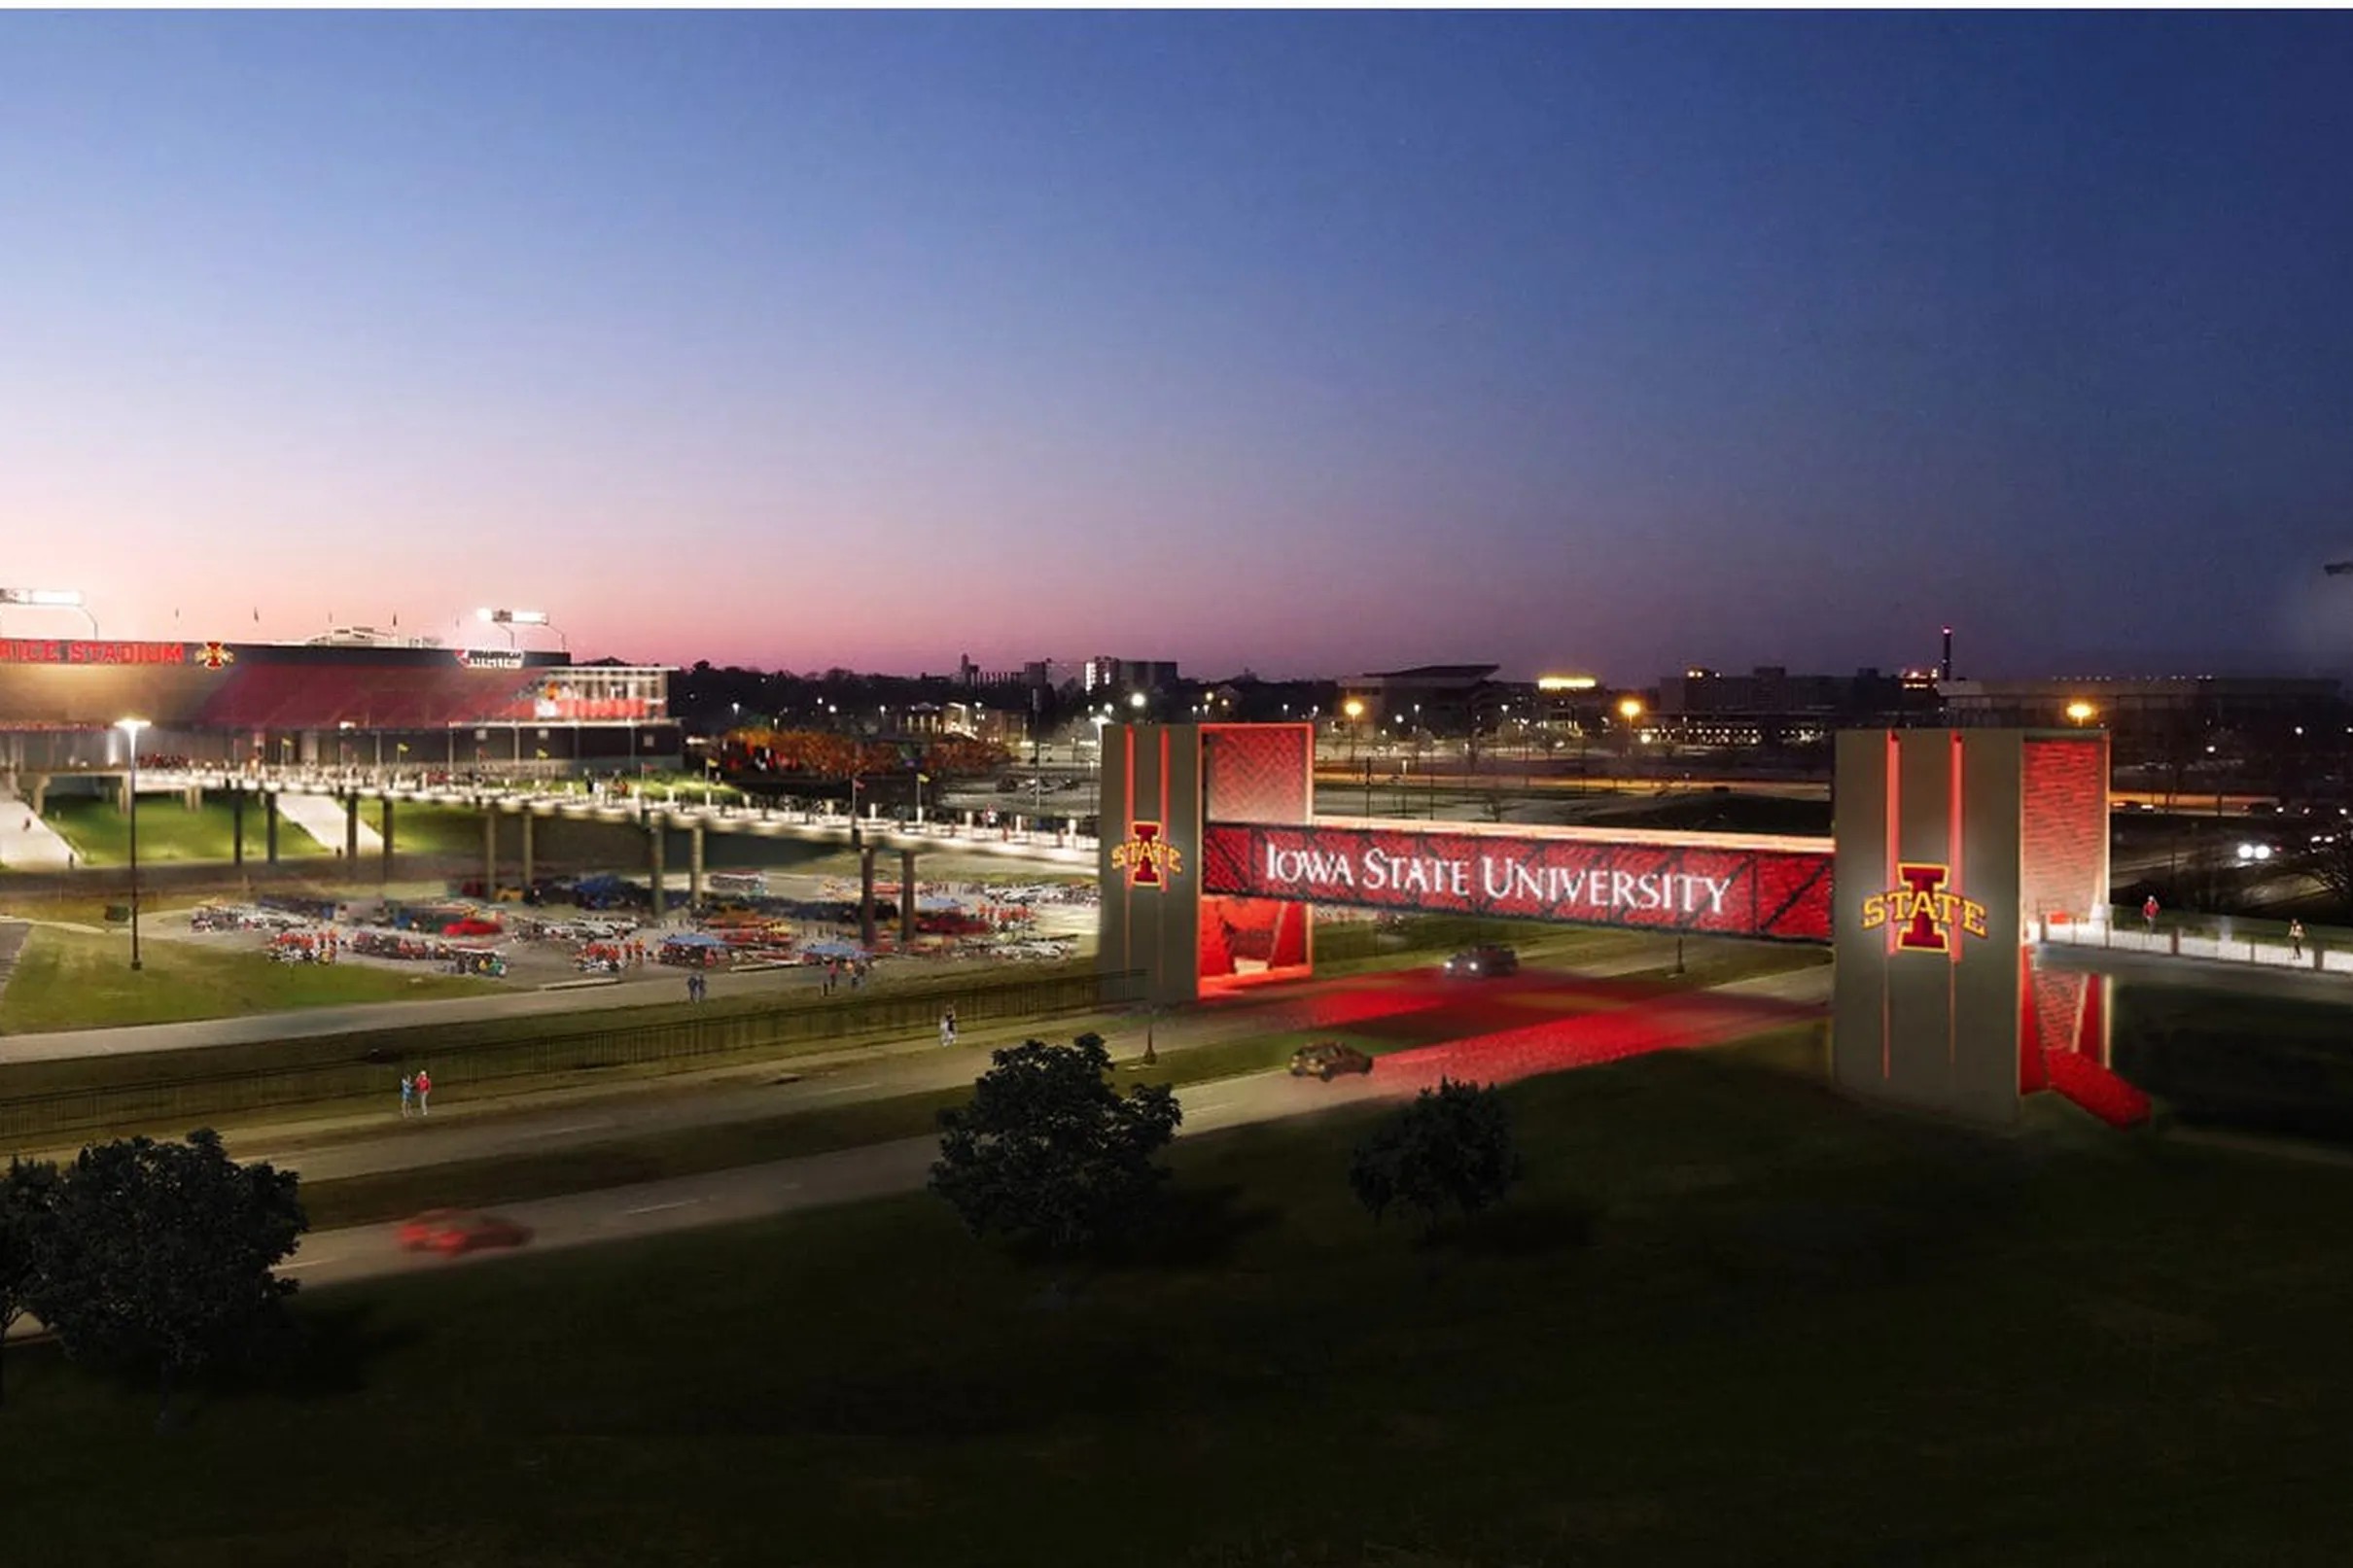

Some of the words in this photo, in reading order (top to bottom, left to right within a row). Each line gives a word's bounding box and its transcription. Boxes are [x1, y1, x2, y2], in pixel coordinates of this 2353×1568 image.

[68, 641, 185, 664] STADIUM
[1111, 841, 1181, 873] STATE
[1862, 890, 1987, 939] STATE
